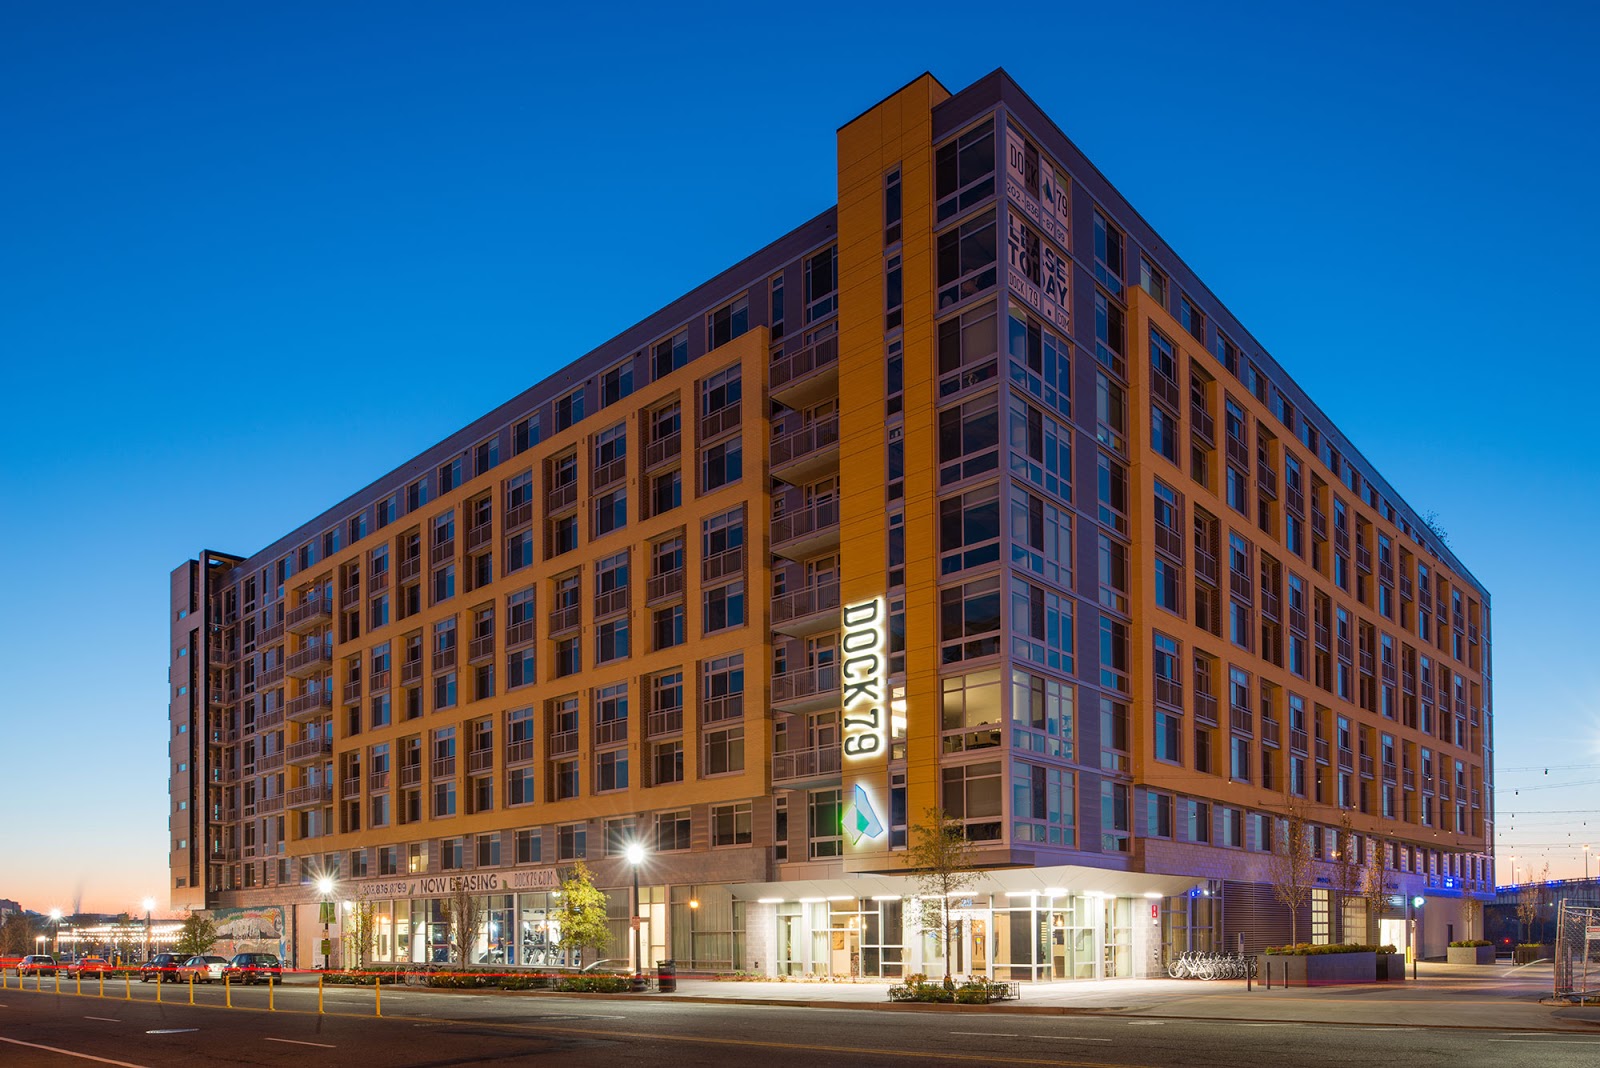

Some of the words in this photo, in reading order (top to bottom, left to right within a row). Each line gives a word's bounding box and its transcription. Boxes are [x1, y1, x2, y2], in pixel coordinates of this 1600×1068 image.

[1010, 143, 1038, 190] DOCK
[1056, 188, 1068, 218] 79
[420, 877, 446, 894] NOW
